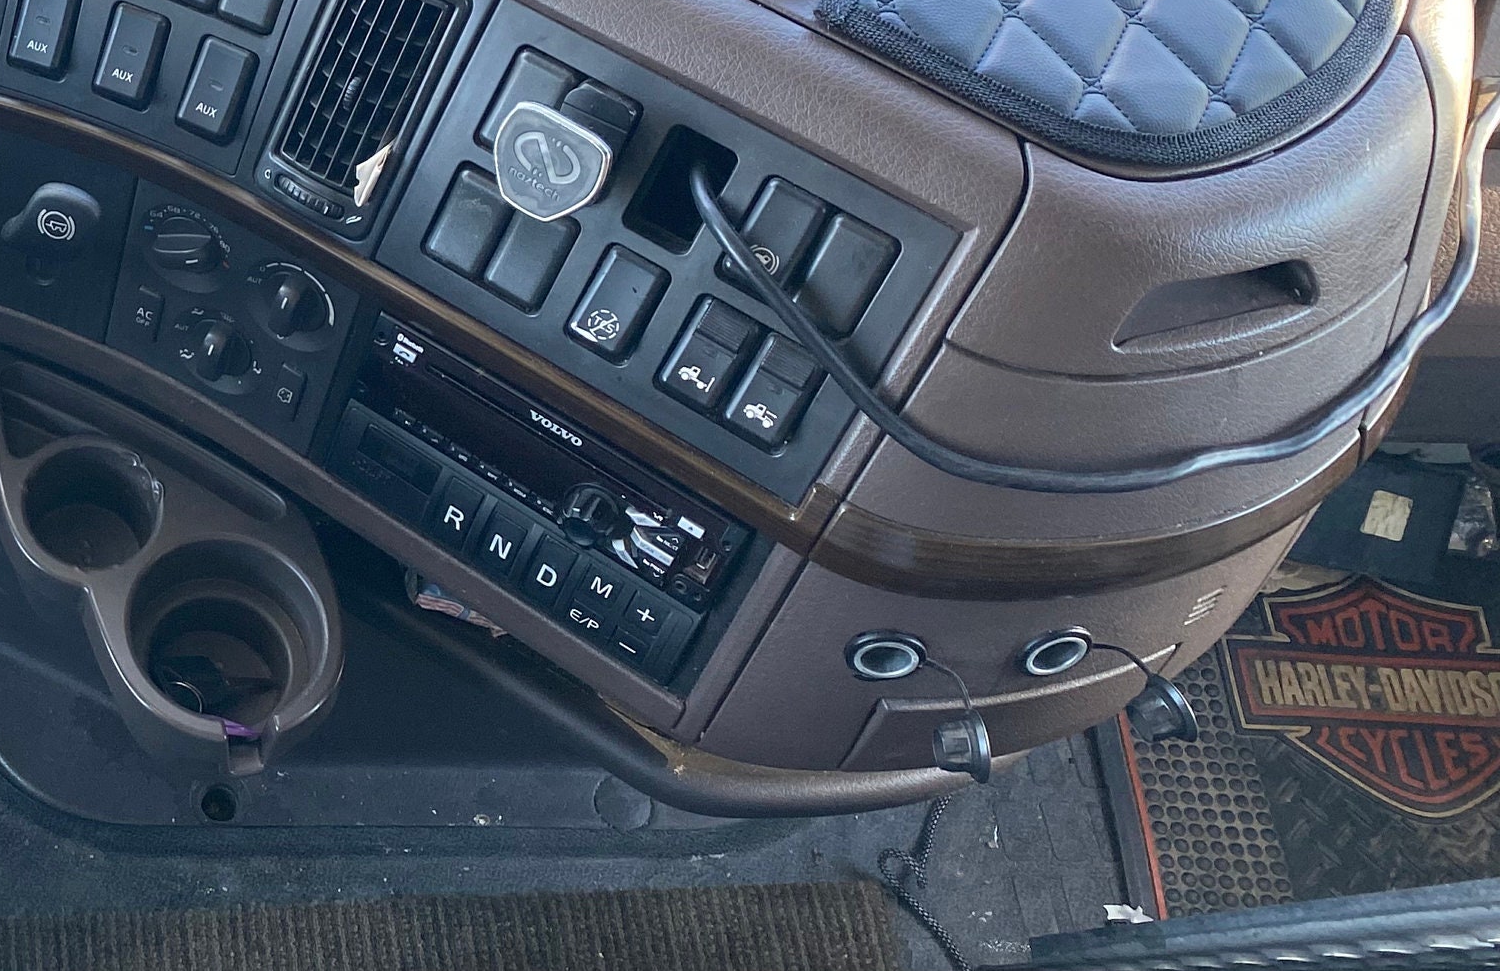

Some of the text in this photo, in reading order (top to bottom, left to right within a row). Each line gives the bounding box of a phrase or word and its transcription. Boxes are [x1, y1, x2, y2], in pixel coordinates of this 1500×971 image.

[27, 40, 48, 54] AUX
[112, 68, 133, 83] AUX
[195, 102, 218, 118] AUX
[136, 316, 150, 327] OFF
[137, 307, 153, 320] AC
[530, 409, 583, 447] VOLVO
[444, 505, 464, 530] R
[489, 533, 512, 559] N
[536, 563, 558, 587] D
[590, 576, 613, 599] M
[570, 608, 600, 629] E/P
[1305, 597, 1454, 652] MOTOR
[1338, 726, 1490, 790] CYCLES
